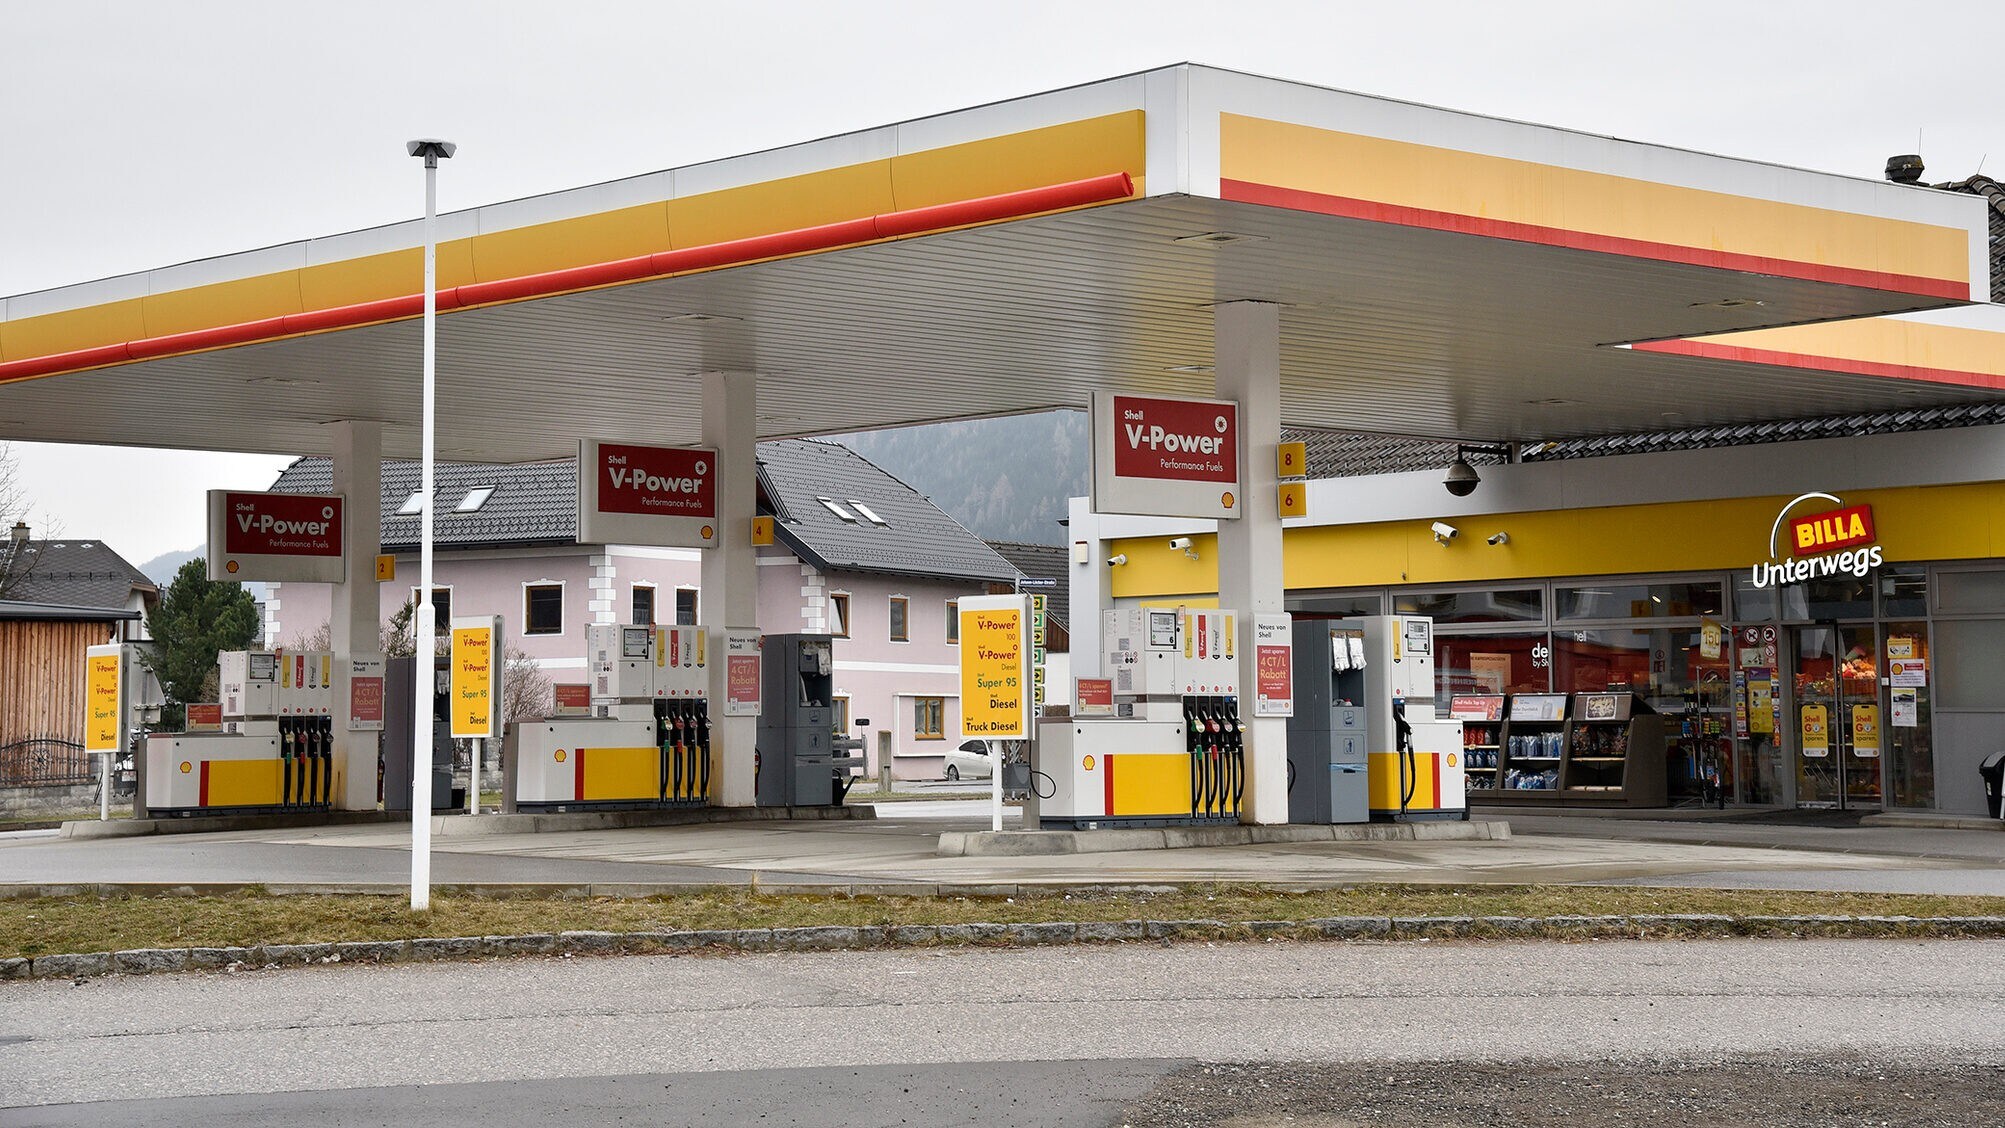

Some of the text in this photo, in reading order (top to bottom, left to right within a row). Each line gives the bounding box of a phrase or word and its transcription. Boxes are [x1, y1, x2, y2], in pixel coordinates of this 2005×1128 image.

[1124, 410, 1144, 420] Shell
[1124, 424, 1223, 454] V-Power
[608, 455, 626, 464] Shell
[1285, 453, 1292, 466] 8
[1160, 458, 1223, 472] Performance Fuels
[608, 467, 702, 494] V-Power
[642, 497, 702, 508] Performance Fuels
[1286, 494, 1293, 506] 6
[236, 514, 329, 535] V-Power
[756, 526, 761, 536] 4
[1796, 513, 1866, 548] BILLA
[269, 539, 329, 548] Performance Fuels
[380, 563, 384, 572] 2
[1753, 546, 1882, 588] Unterwegs
[978, 621, 1015, 630] V-Power
[1532, 642, 1548, 658] de
[978, 651, 1016, 660] V-Power
[1533, 659, 1540, 668] by
[978, 678, 1017, 690] Super 95
[462, 690, 478, 700] Super
[990, 699, 1017, 708] Diesel
[95, 711, 108, 719] Super
[470, 716, 486, 724] Diesel
[966, 721, 1017, 731] Truck Diesel
